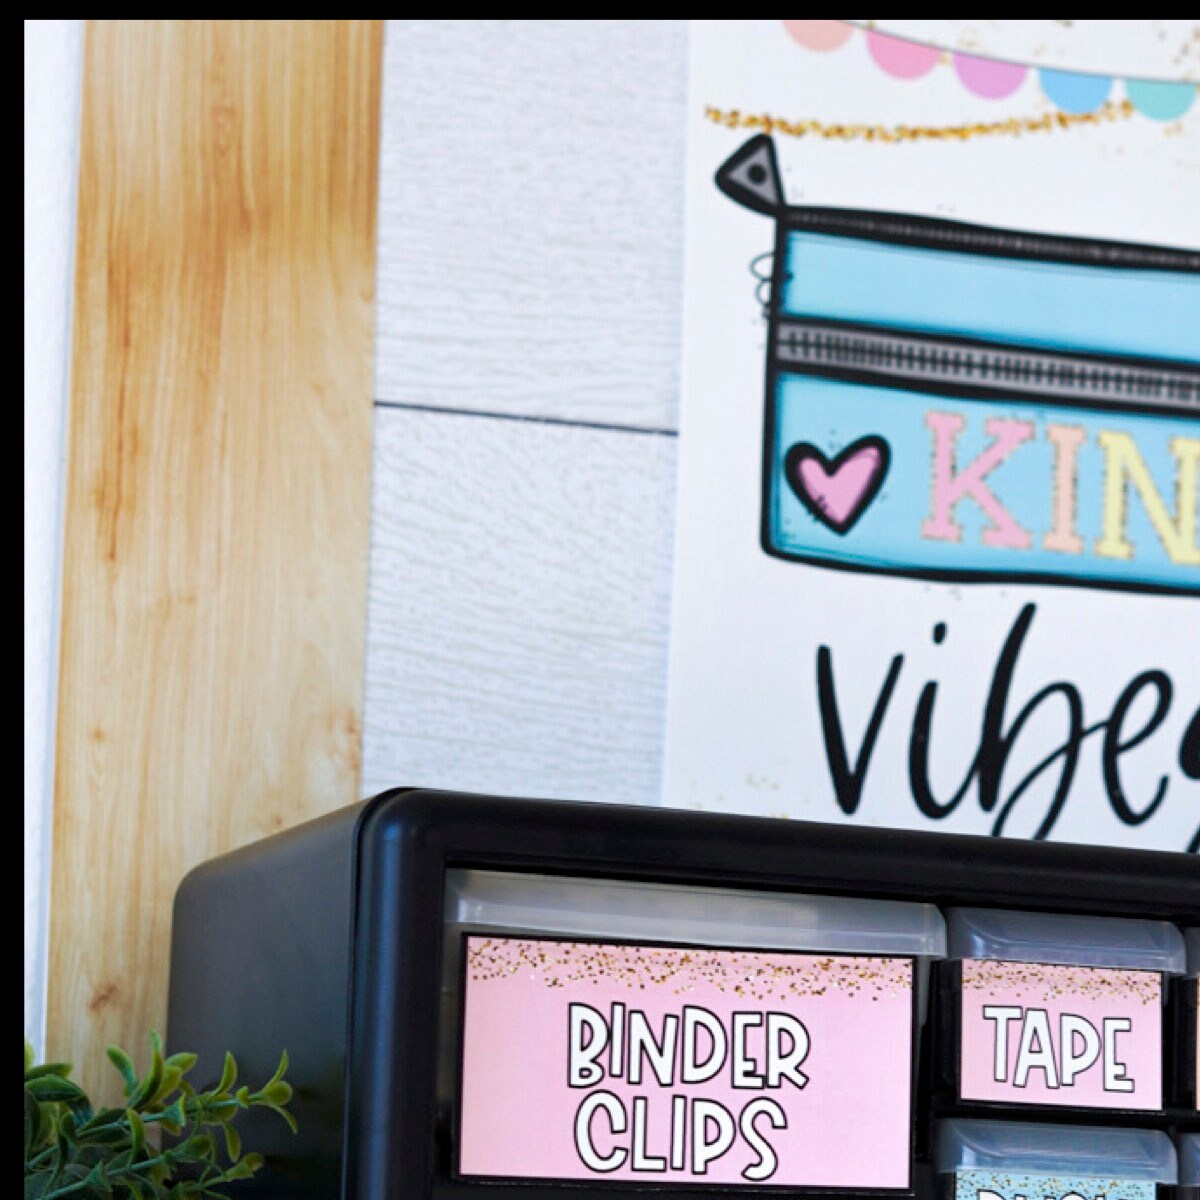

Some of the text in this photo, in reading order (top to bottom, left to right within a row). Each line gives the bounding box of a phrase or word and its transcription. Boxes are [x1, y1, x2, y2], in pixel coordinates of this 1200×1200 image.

[567, 1002, 811, 1090] BINDER
[983, 1005, 1135, 1093] TAPE
[574, 1089, 788, 1181] CLIPS
